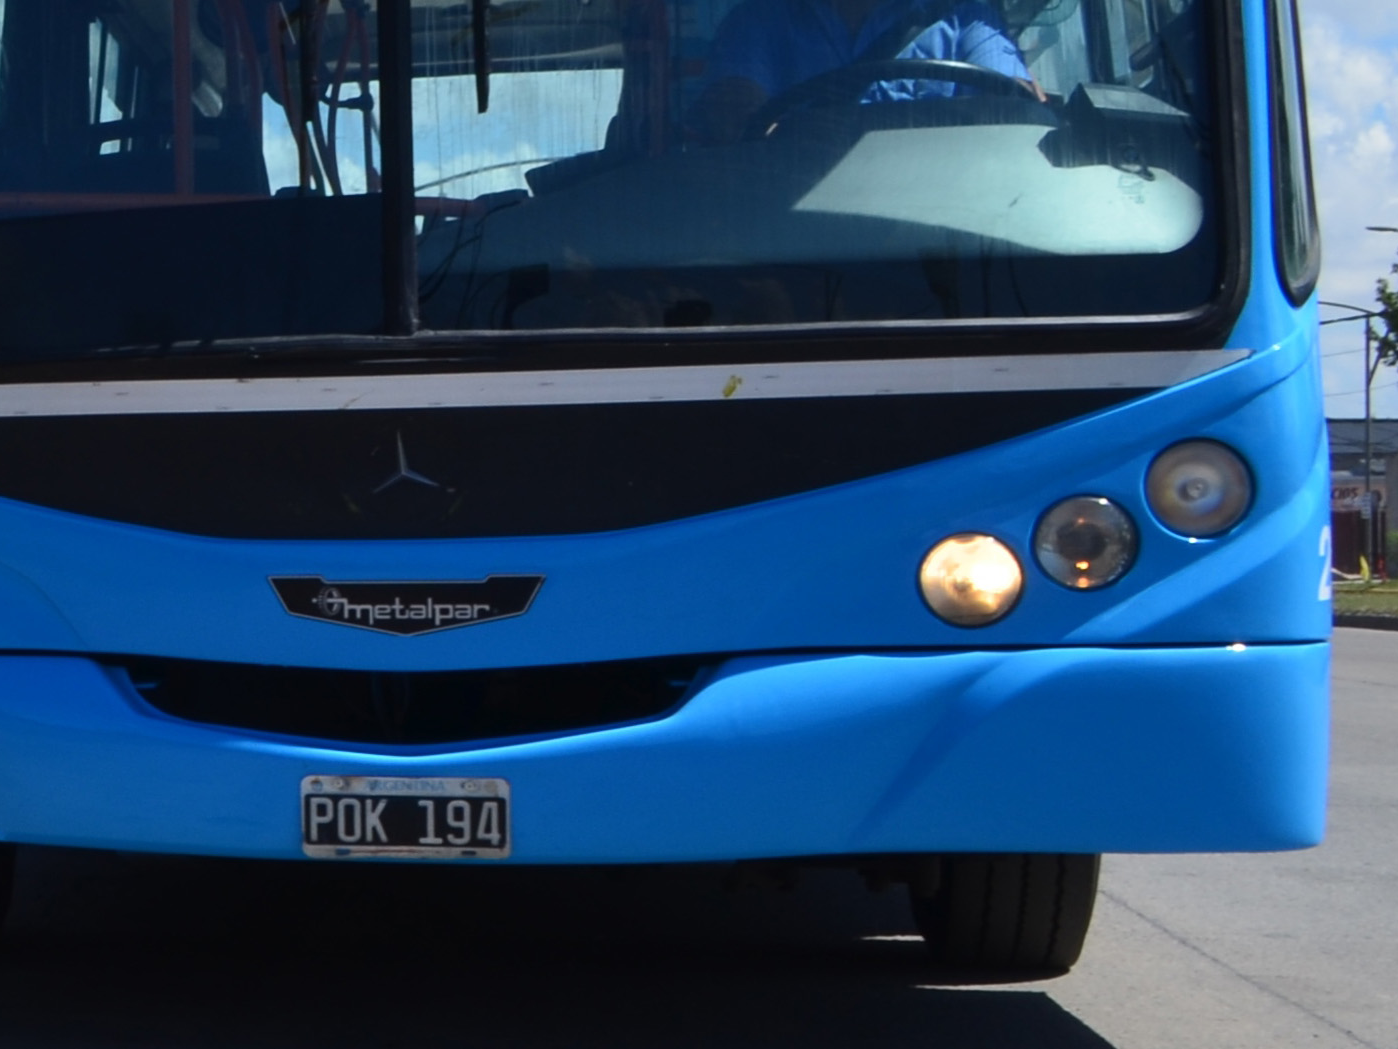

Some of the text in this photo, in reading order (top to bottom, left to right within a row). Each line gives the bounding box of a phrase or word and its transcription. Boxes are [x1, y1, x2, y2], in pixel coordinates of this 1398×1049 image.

[341, 597, 490, 625] metalpar
[309, 797, 501, 845] POK 194
